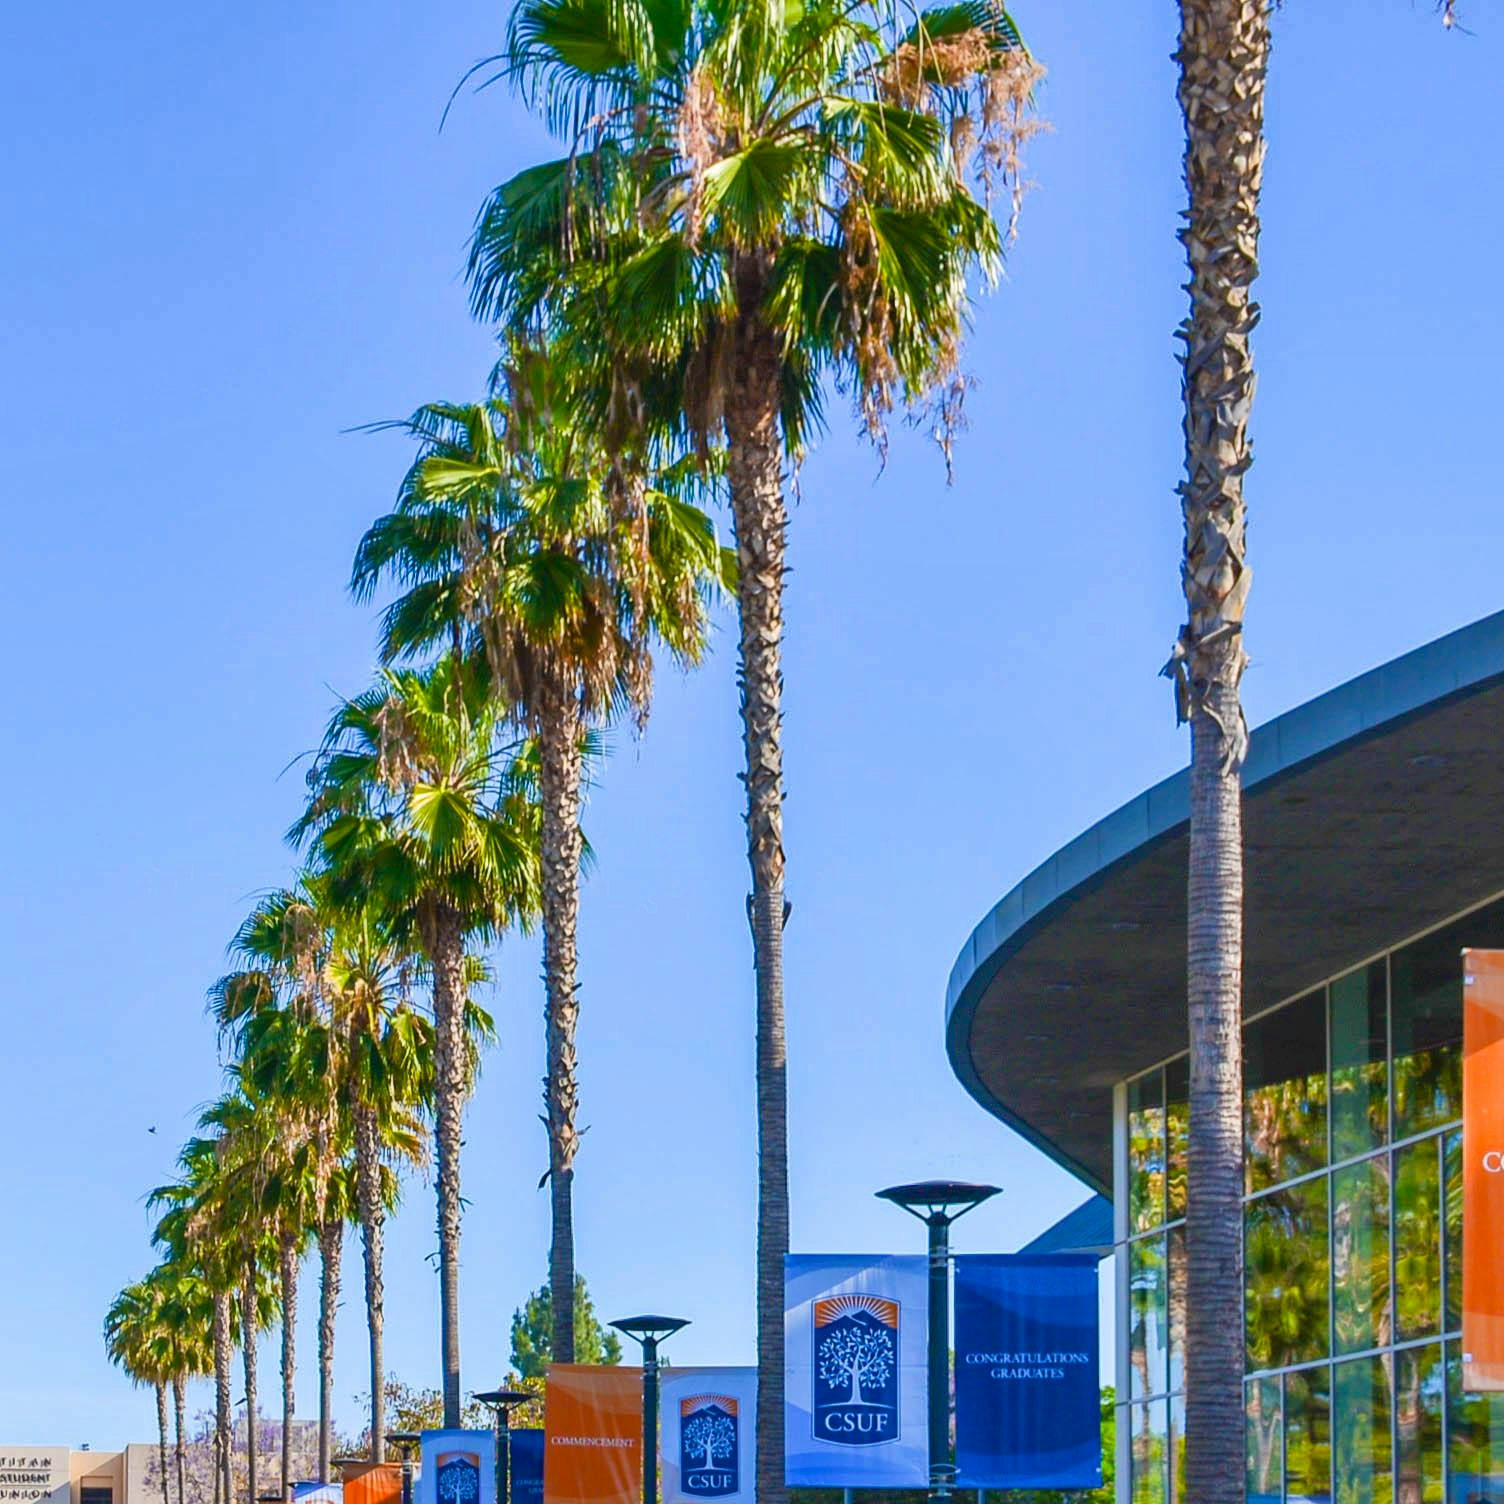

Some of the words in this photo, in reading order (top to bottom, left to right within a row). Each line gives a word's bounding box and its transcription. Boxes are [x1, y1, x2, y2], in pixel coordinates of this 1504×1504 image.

[965, 1353, 1089, 1364] CONGRATULATIONS
[990, 1368, 1065, 1379] GRADUATES
[825, 1412, 889, 1432] CSUF
[551, 1436, 634, 1447] COMMENCEMENT
[688, 1474, 732, 1488] CSUF
